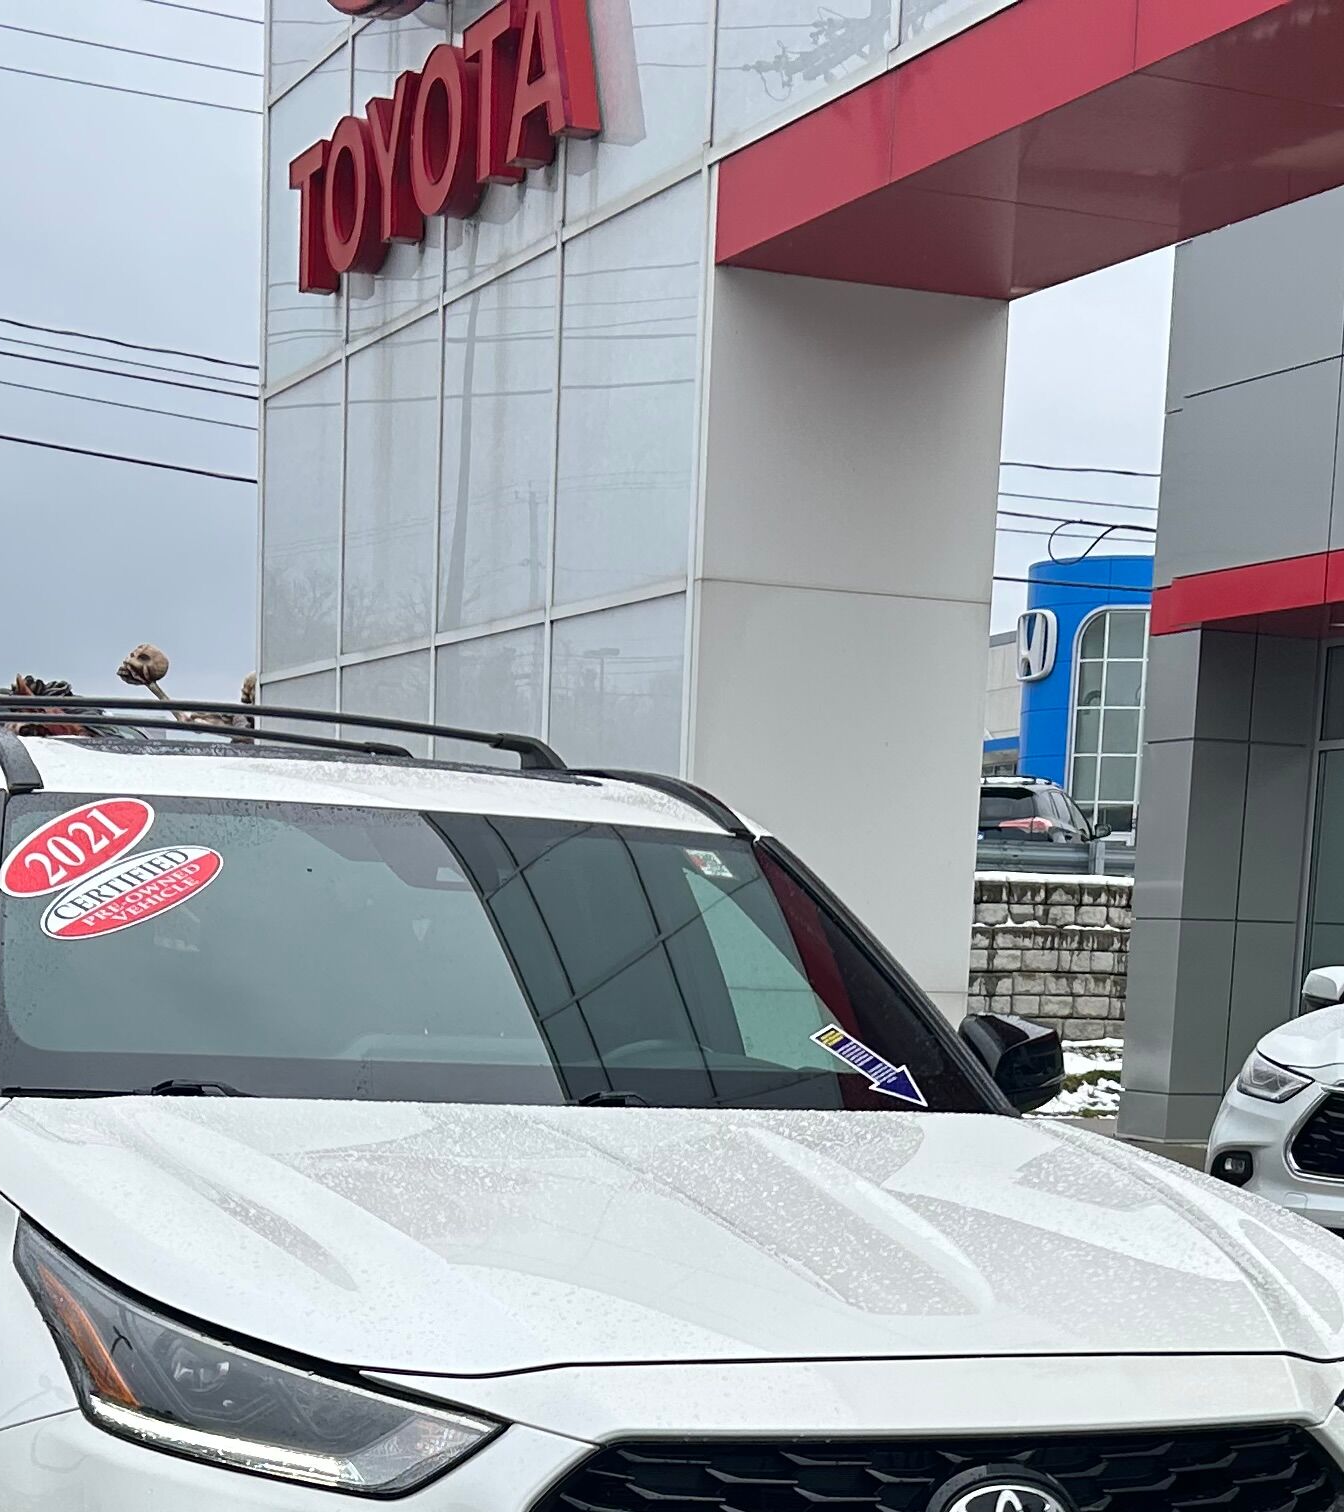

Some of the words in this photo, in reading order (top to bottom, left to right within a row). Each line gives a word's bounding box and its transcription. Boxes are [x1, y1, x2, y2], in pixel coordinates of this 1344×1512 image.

[289, 0, 600, 294] TOYOTA
[24, 807, 129, 887] 2021
[53, 849, 190, 920] CERTIFIED
[82, 862, 201, 927] PRE-OWNED
[109, 877, 200, 923] VEHICLE
